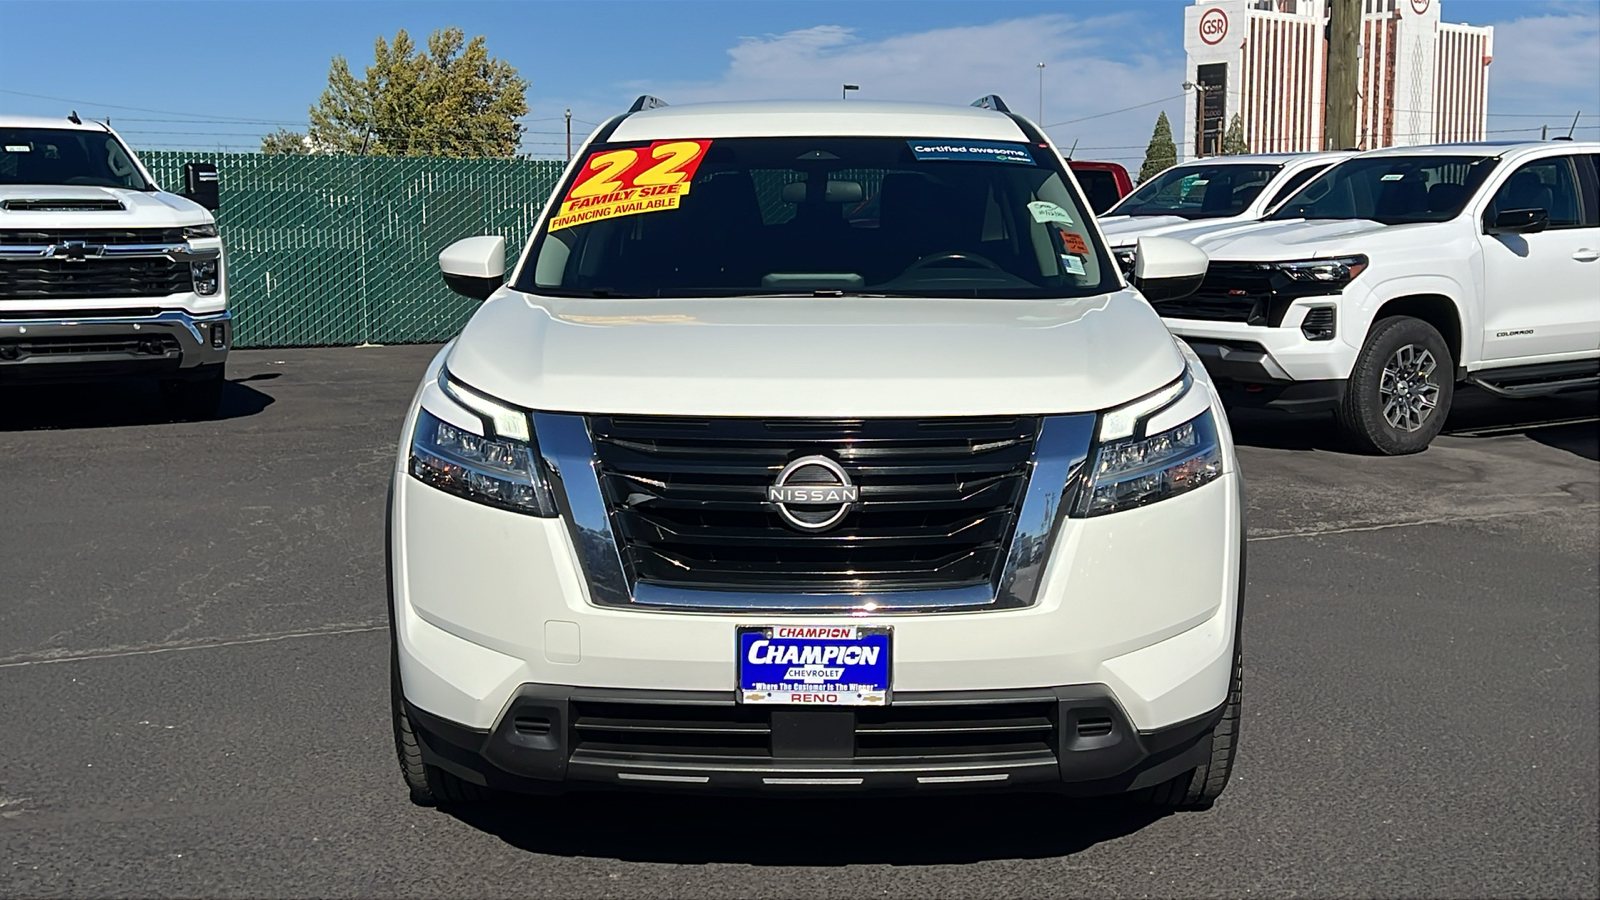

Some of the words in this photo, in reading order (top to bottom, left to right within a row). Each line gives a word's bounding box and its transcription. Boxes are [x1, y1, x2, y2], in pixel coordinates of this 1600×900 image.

[1202, 18, 1224, 35] GSR
[914, 145, 967, 153] Certified
[968, 147, 1028, 157] awesome.
[570, 141, 702, 198] 22
[568, 189, 637, 212] FAMILY
[638, 183, 681, 198] SIZE
[552, 207, 611, 229] FINANCING
[613, 197, 676, 214] AVAILABLE
[1496, 329, 1534, 338] COLORADO
[770, 489, 856, 501] NISSAN
[778, 628, 851, 638] CHAMPION
[788, 669, 840, 678] CHEVROLET
[779, 682, 792, 691] The
[793, 682, 827, 691] Customer
[835, 683, 849, 691] The
[790, 693, 838, 703] RENO
